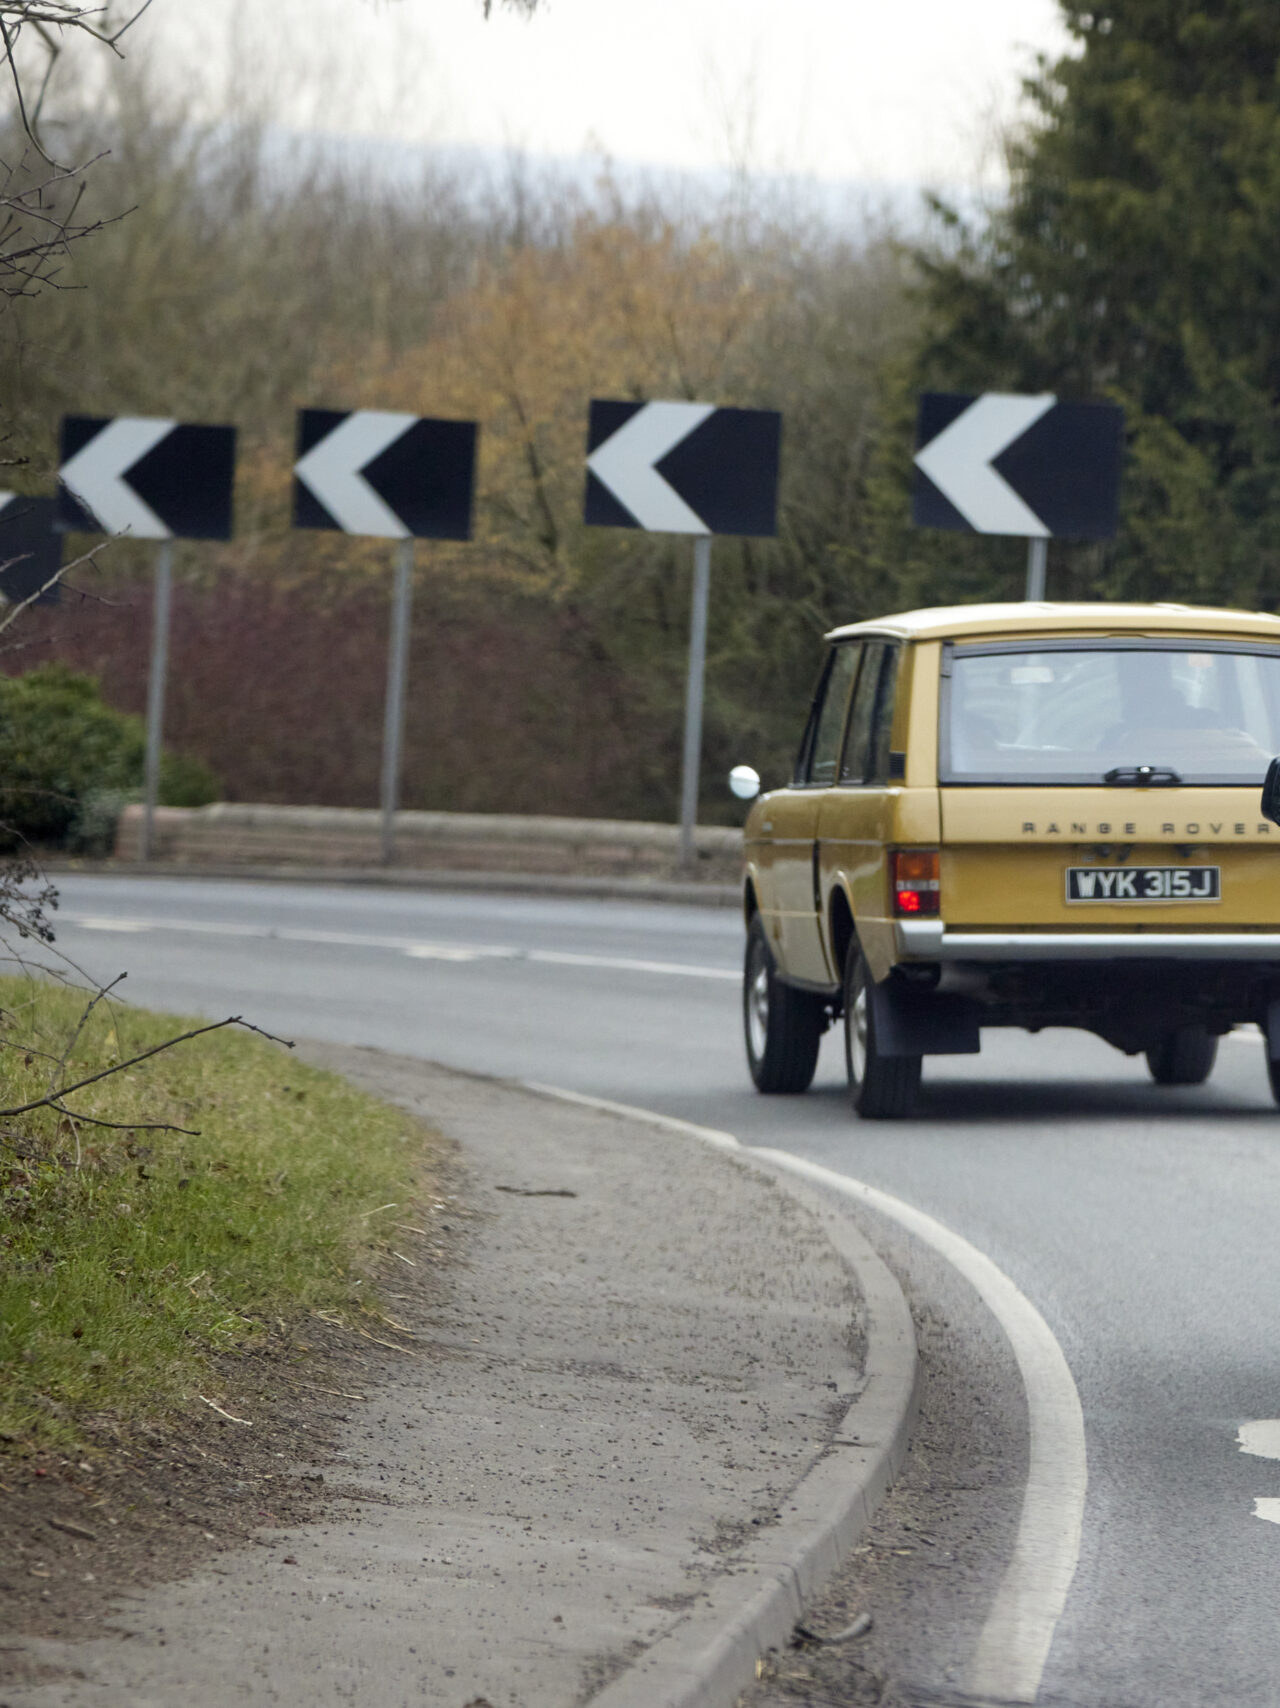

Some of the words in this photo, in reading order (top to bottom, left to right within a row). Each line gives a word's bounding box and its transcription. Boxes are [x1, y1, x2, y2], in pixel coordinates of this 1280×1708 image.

[1022, 822, 1136, 835] RANGE
[1162, 822, 1271, 835] ROVER
[1076, 871, 1138, 898] WYK
[1144, 870, 1212, 897] 315J
